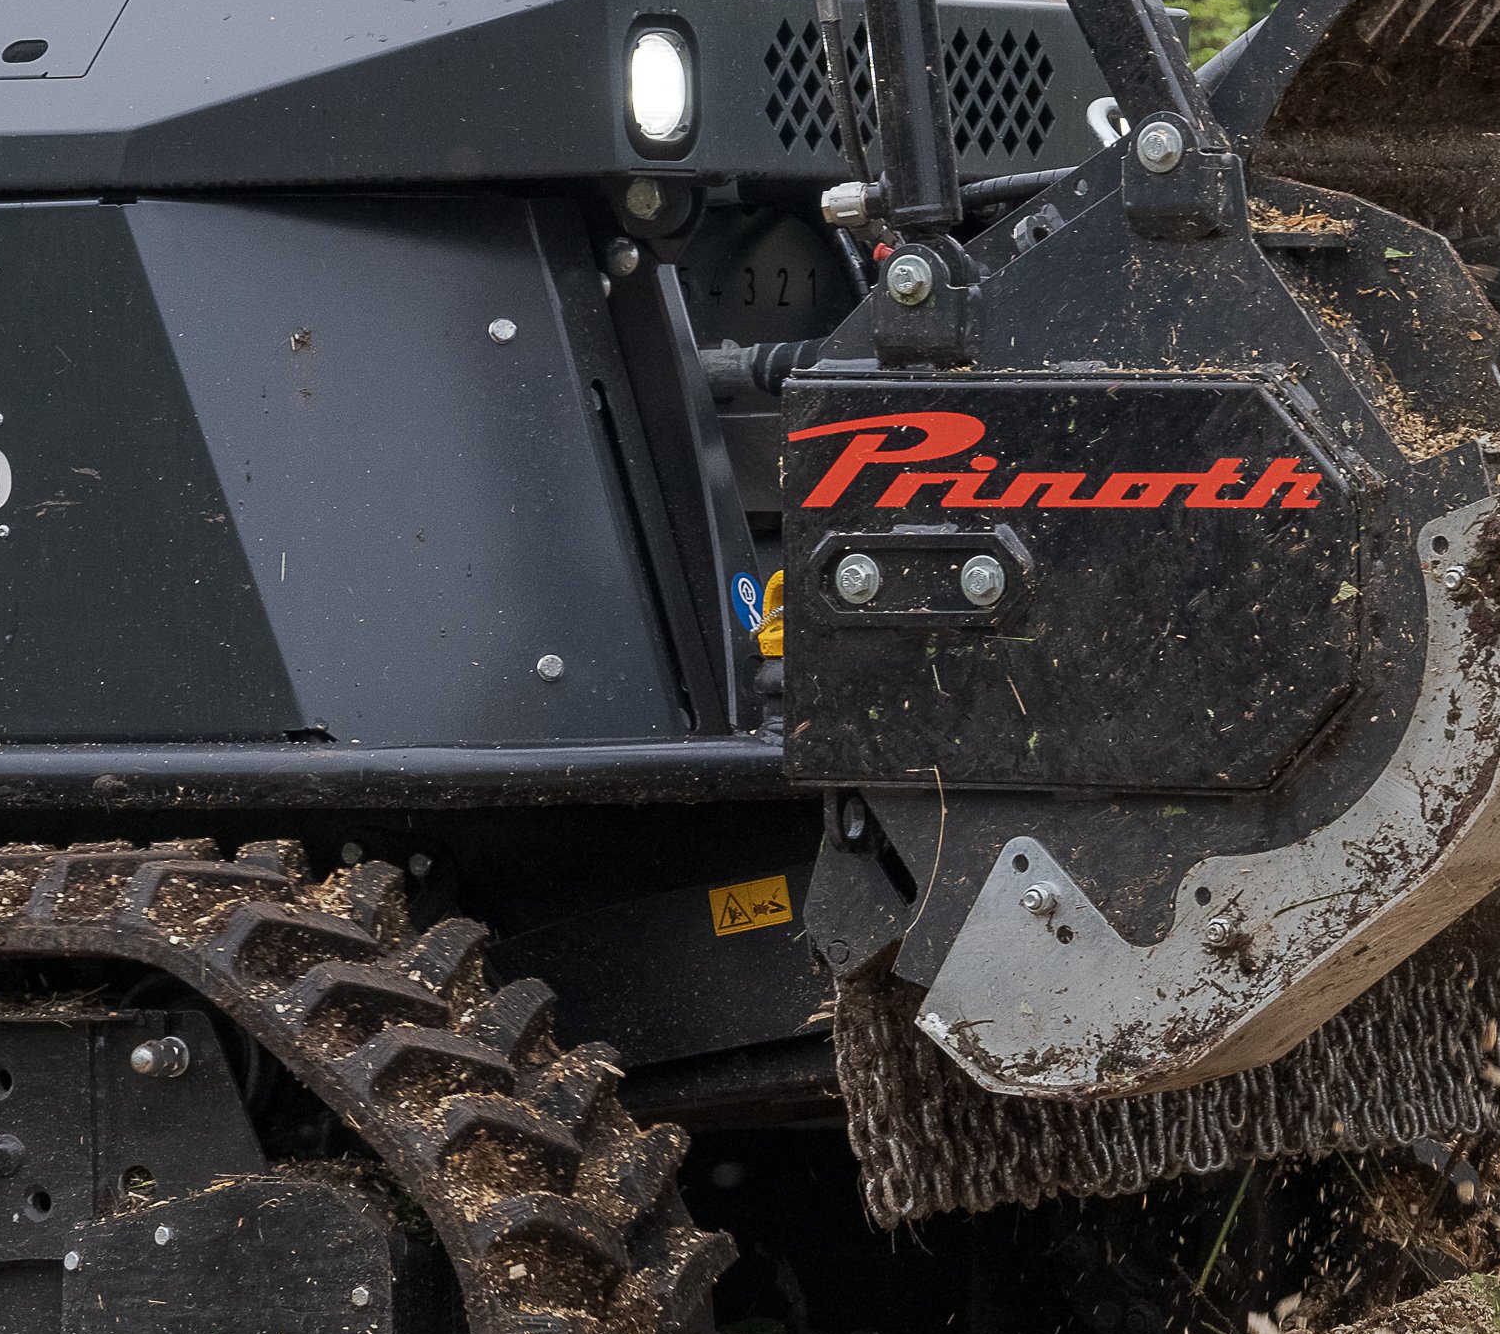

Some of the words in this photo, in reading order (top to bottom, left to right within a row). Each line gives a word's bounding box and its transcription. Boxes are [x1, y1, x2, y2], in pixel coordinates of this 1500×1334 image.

[708, 267, 723, 306] 4
[744, 266, 756, 306] 3
[777, 267, 790, 307] 2
[808, 266, 817, 307] 1
[787, 411, 1323, 509] Prinoth
